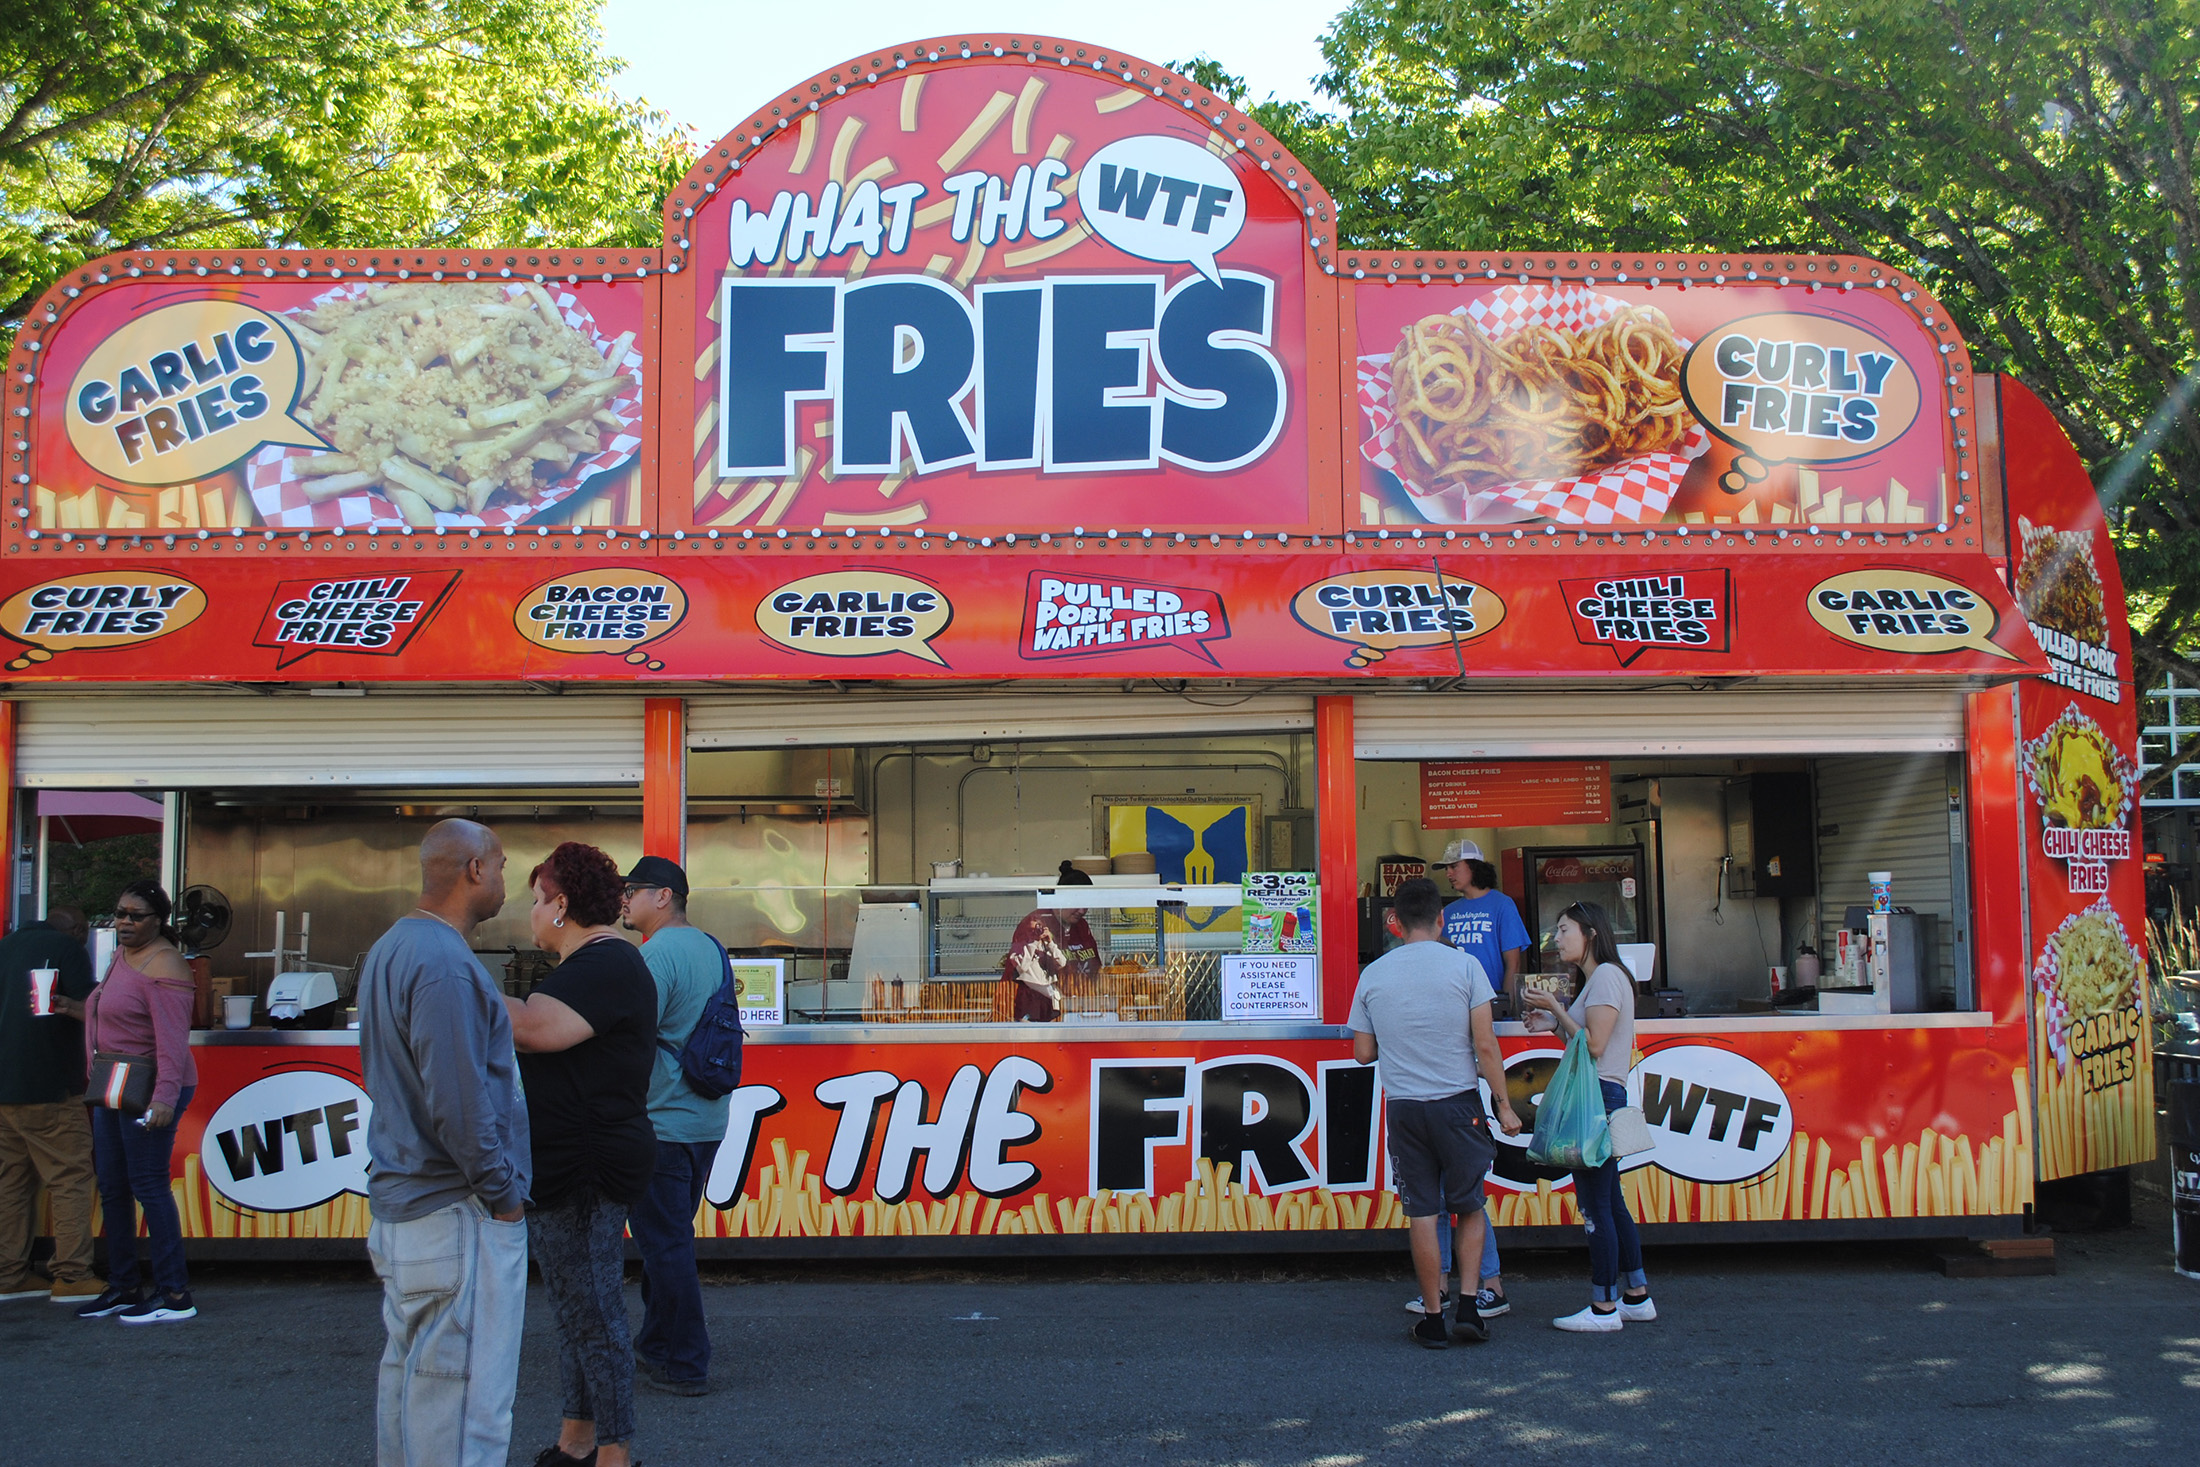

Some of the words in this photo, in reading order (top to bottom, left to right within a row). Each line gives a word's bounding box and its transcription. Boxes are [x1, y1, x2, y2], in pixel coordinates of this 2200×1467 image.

[1099, 163, 1234, 235] WTF
[729, 180, 925, 267] WHAT
[943, 158, 1068, 246] THE
[78, 319, 276, 424] GARLIC
[718, 270, 1288, 477] FRIES
[1715, 333, 1896, 397] CURLY
[113, 375, 269, 466] FRIES
[1720, 383, 1878, 443] FRIES
[29, 585, 193, 610] CURLY
[309, 577, 410, 602] CHILI
[545, 585, 665, 604] BACON
[1041, 578, 1182, 614] PULLED
[1316, 583, 1477, 609] CURLY
[1595, 575, 1684, 600] CHILI
[277, 599, 423, 624] CHEESE
[529, 603, 671, 623] CHEESE
[771, 590, 938, 615] GARLIC
[1577, 597, 1716, 621] CHEESE
[1816, 589, 1979, 613] GARLIC
[23, 609, 166, 636] FRIES
[789, 615, 915, 639] FRIES
[1036, 601, 1113, 629] PORK
[1328, 608, 1476, 635] FRIES
[1846, 613, 1973, 637] FRIES
[278, 620, 395, 648] FRIES
[542, 621, 647, 640] FRIES
[1032, 618, 1125, 651] WAFFLE
[1131, 610, 1210, 640] FRIES
[1596, 618, 1712, 645] FRIES
[2079, 640, 2118, 677] PORK
[2041, 657, 2082, 692] FFLE
[2082, 669, 2120, 704] FRIES
[2043, 827, 2080, 858] CHILI
[2081, 829, 2129, 859] CHEESE
[1251, 875, 1307, 889] $3.64
[1383, 864, 1424, 874] HAND
[1383, 875, 1424, 886] WA
[1584, 866, 1600, 874] ICE
[1603, 866, 1629, 874] COLD
[2069, 862, 2108, 893] FRIES
[1447, 921, 1492, 933] STATE
[1450, 912, 1489, 921] Washington
[1450, 932, 1483, 945] FAIR
[1240, 971, 1296, 979] ASSISTANCE
[1271, 961, 1297, 969] NEED
[1250, 981, 1286, 989] PLEASE
[750, 1010, 779, 1021] HERE
[1230, 1001, 1308, 1010] COUNTERPERSON
[2070, 1005, 2141, 1059] GARLIC
[2081, 1045, 2135, 1095] FRIES
[1643, 1072, 1782, 1152] WTF
[814, 1055, 1053, 1205] THE
[1089, 1053, 1576, 1200] FRIS
[215, 1098, 361, 1182] WTF
